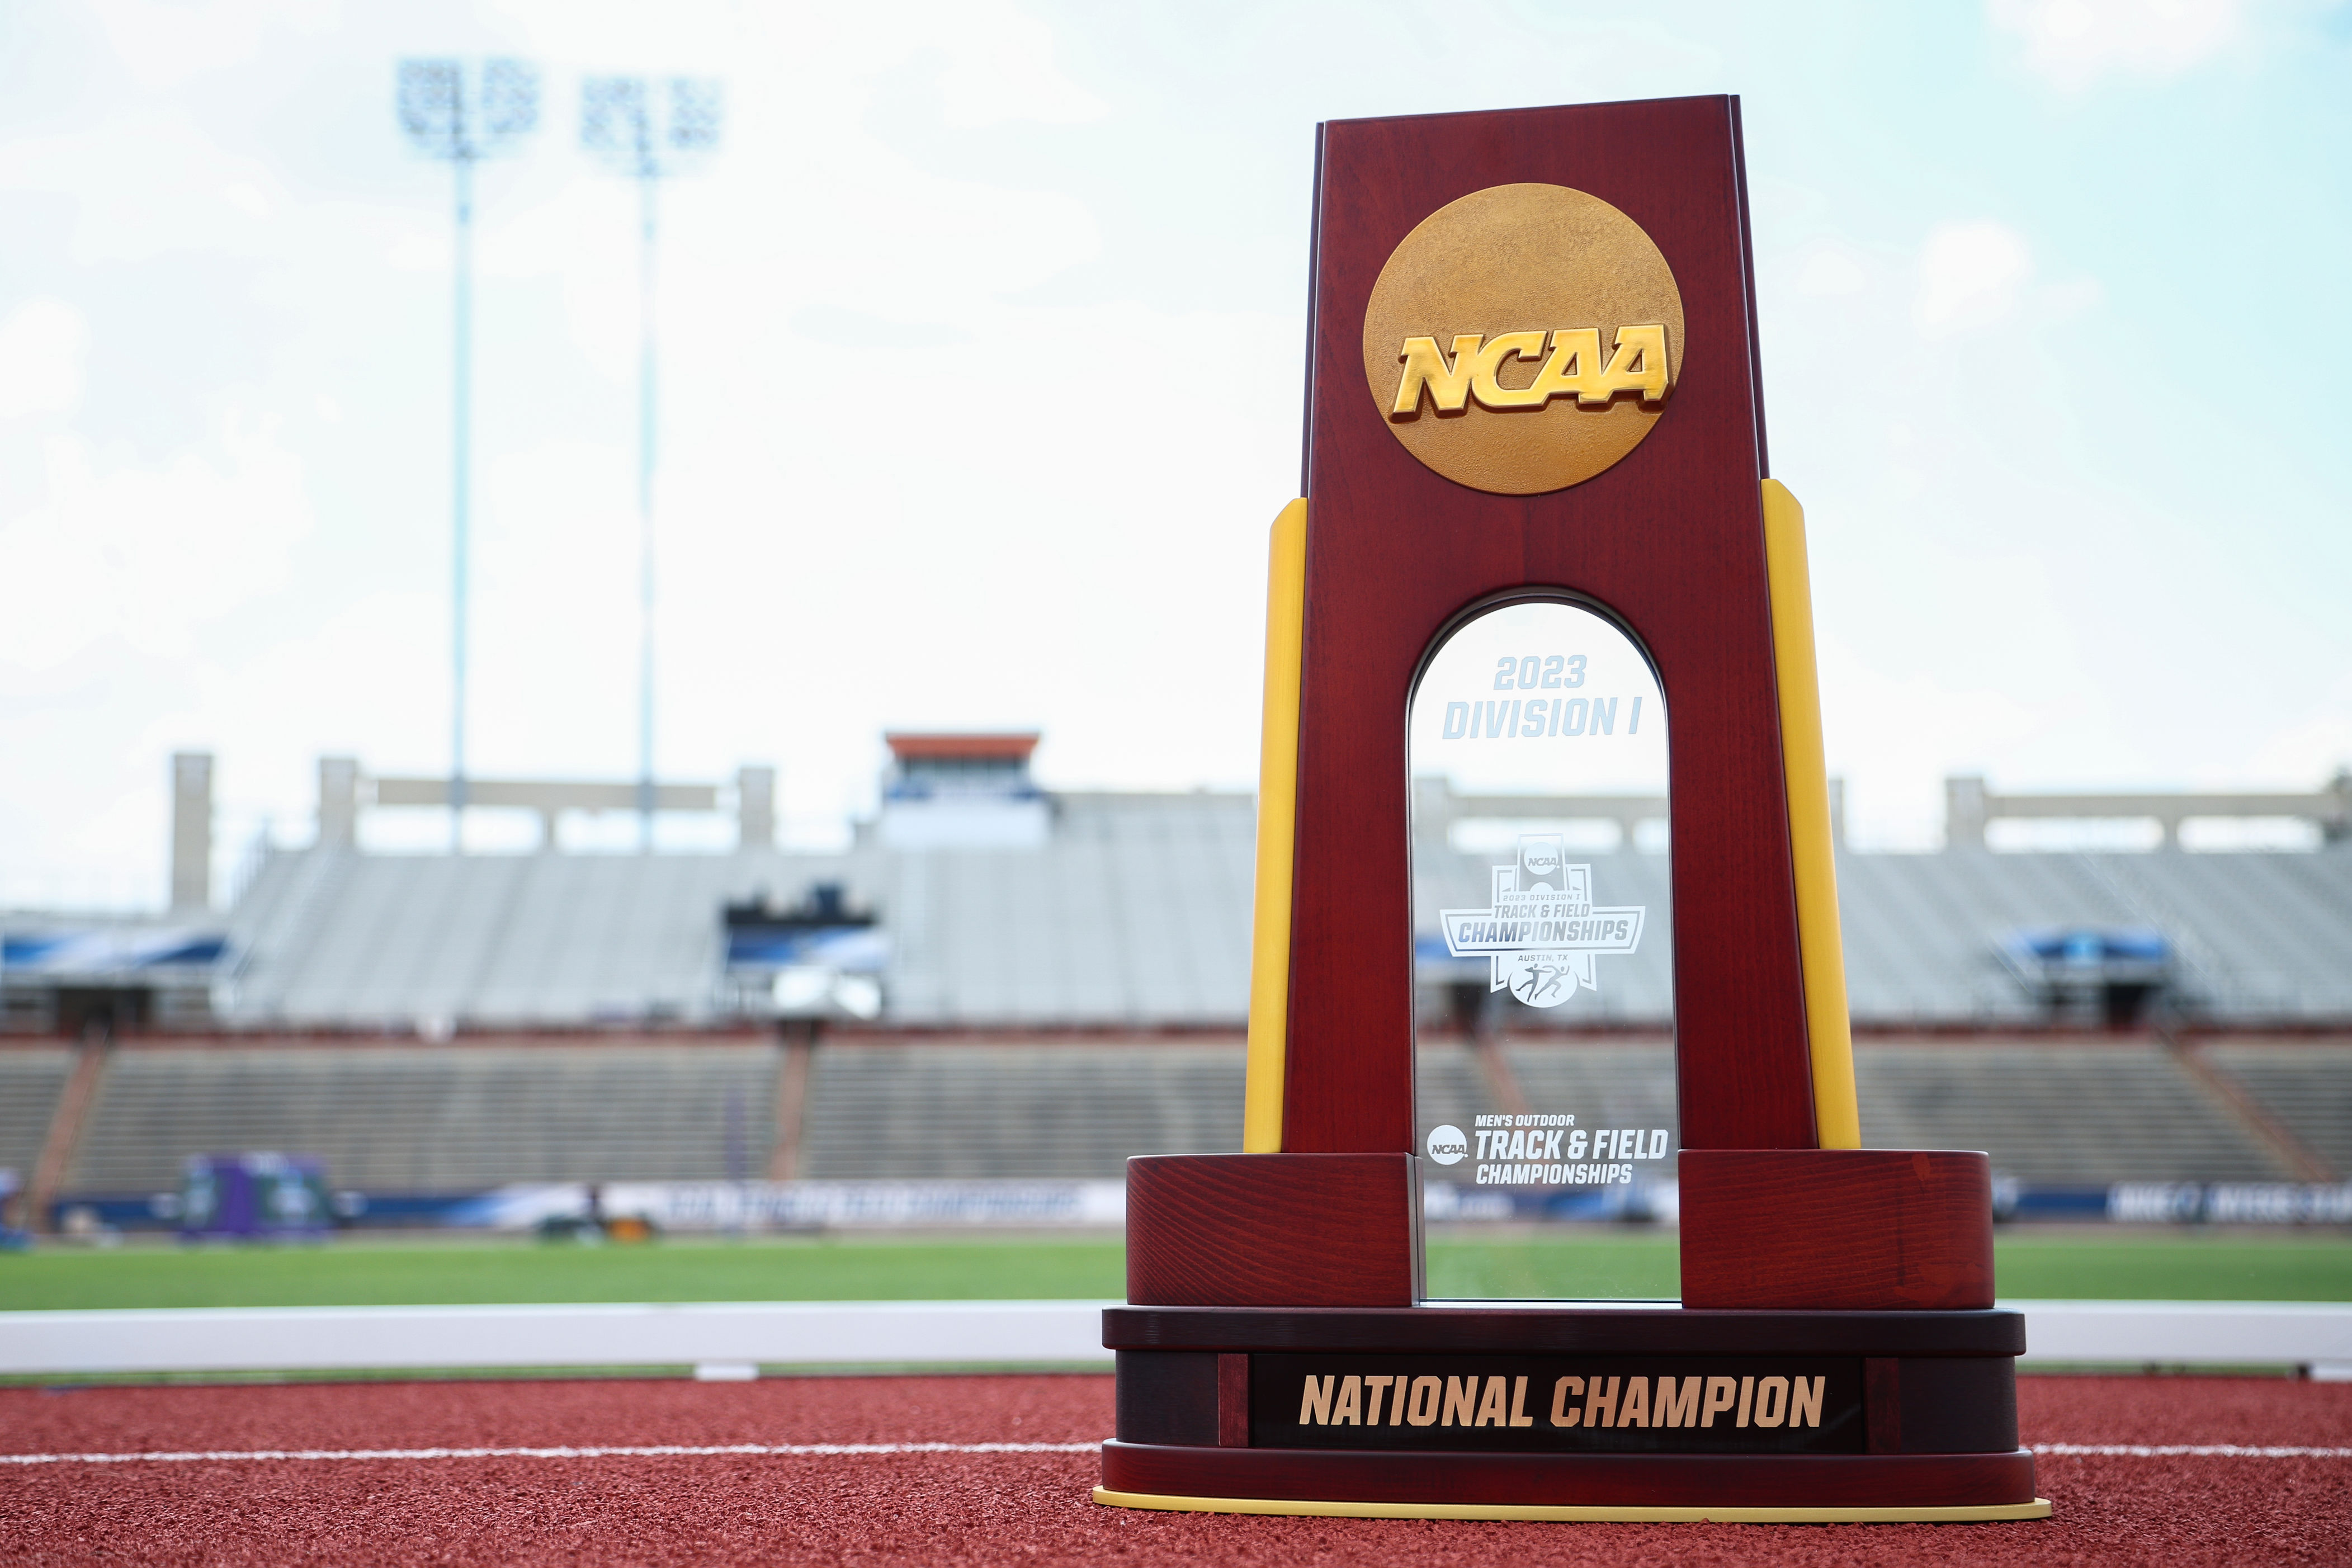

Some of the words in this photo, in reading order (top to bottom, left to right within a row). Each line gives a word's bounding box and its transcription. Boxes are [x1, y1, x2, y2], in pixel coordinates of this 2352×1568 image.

[1391, 324, 1672, 421] NCAA
[1494, 655, 1587, 690] 2023
[1442, 697, 1618, 739] DIVISION
[1628, 697, 1642, 735] I
[1528, 857, 1557, 866] NCAA
[1494, 905, 1537, 918] TRACK
[1540, 904, 1550, 918] &
[1553, 904, 1590, 918] FIELD
[1458, 920, 1628, 943] CHAMPIONSHIPS
[1475, 1114, 1513, 1127] MEN'S
[1515, 1114, 1575, 1126] OUTDOOR
[1432, 1144, 1466, 1155] NCAA
[1475, 1130, 1564, 1160] TRACK
[1567, 1130, 1588, 1160] &
[1593, 1129, 1669, 1160] FIELD
[1476, 1163, 1632, 1184] CHAMPIONSHIPS
[1299, 1375, 1533, 1427] NATIONAL
[1550, 1376, 1826, 1428] CHAMPION
